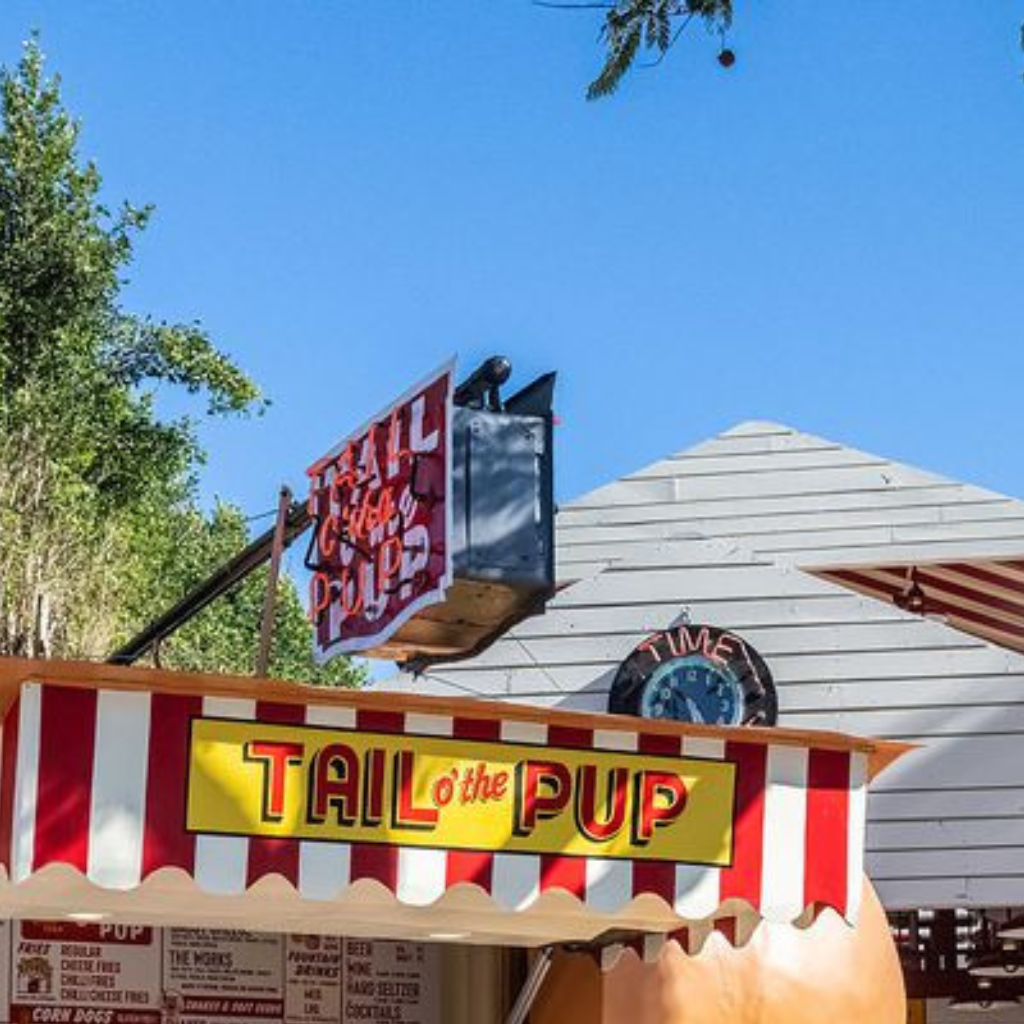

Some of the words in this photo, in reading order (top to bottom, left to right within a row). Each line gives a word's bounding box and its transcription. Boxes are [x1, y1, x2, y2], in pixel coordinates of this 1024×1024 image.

[637, 625, 736, 667] TIME
[243, 741, 439, 831] TAIL
[512, 759, 689, 847] PUP
[98, 922, 144, 940] PUP
[169, 949, 191, 966] THE
[32, 1007, 72, 1022] CORN
[73, 1008, 114, 1024] DOGS
